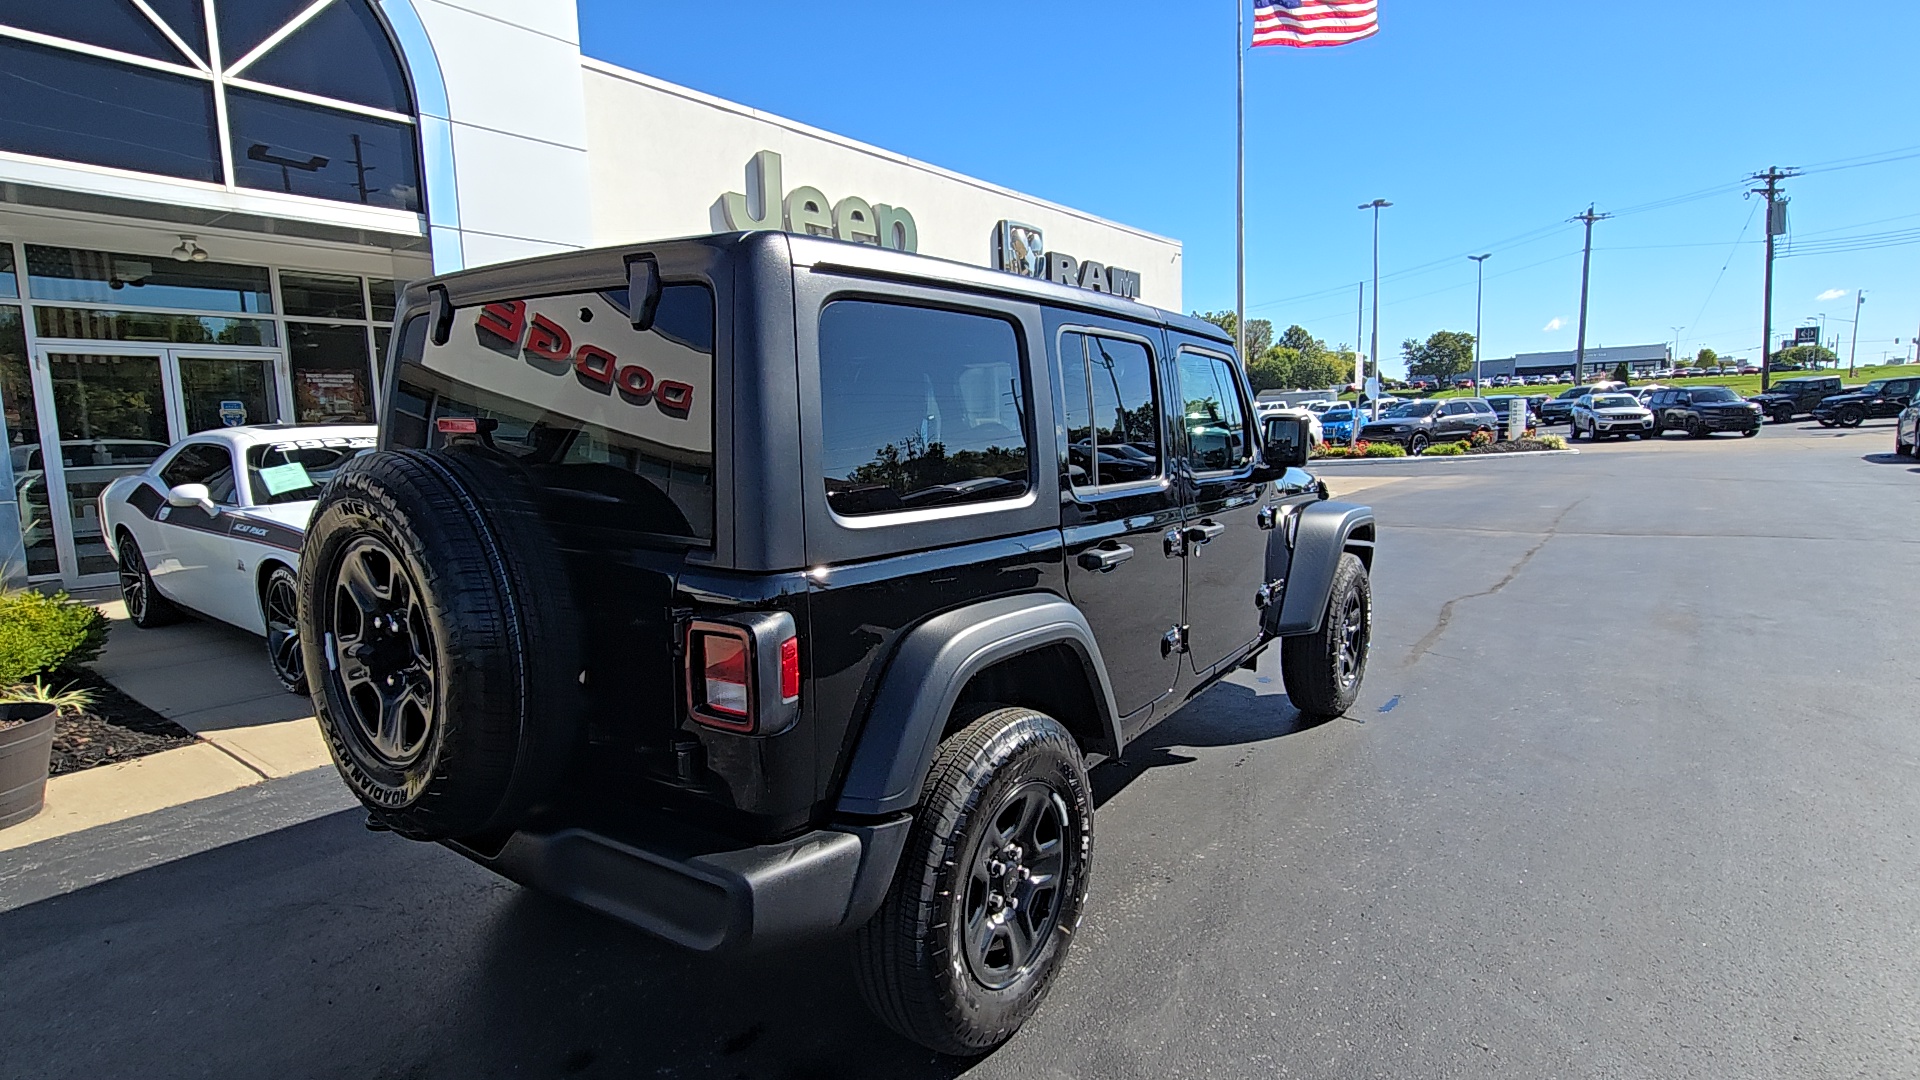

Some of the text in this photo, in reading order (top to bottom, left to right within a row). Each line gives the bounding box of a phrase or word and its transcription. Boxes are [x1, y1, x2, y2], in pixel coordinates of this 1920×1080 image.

[1045, 251, 1141, 299] RAM
[233, 523, 270, 537] SCAT PACK
